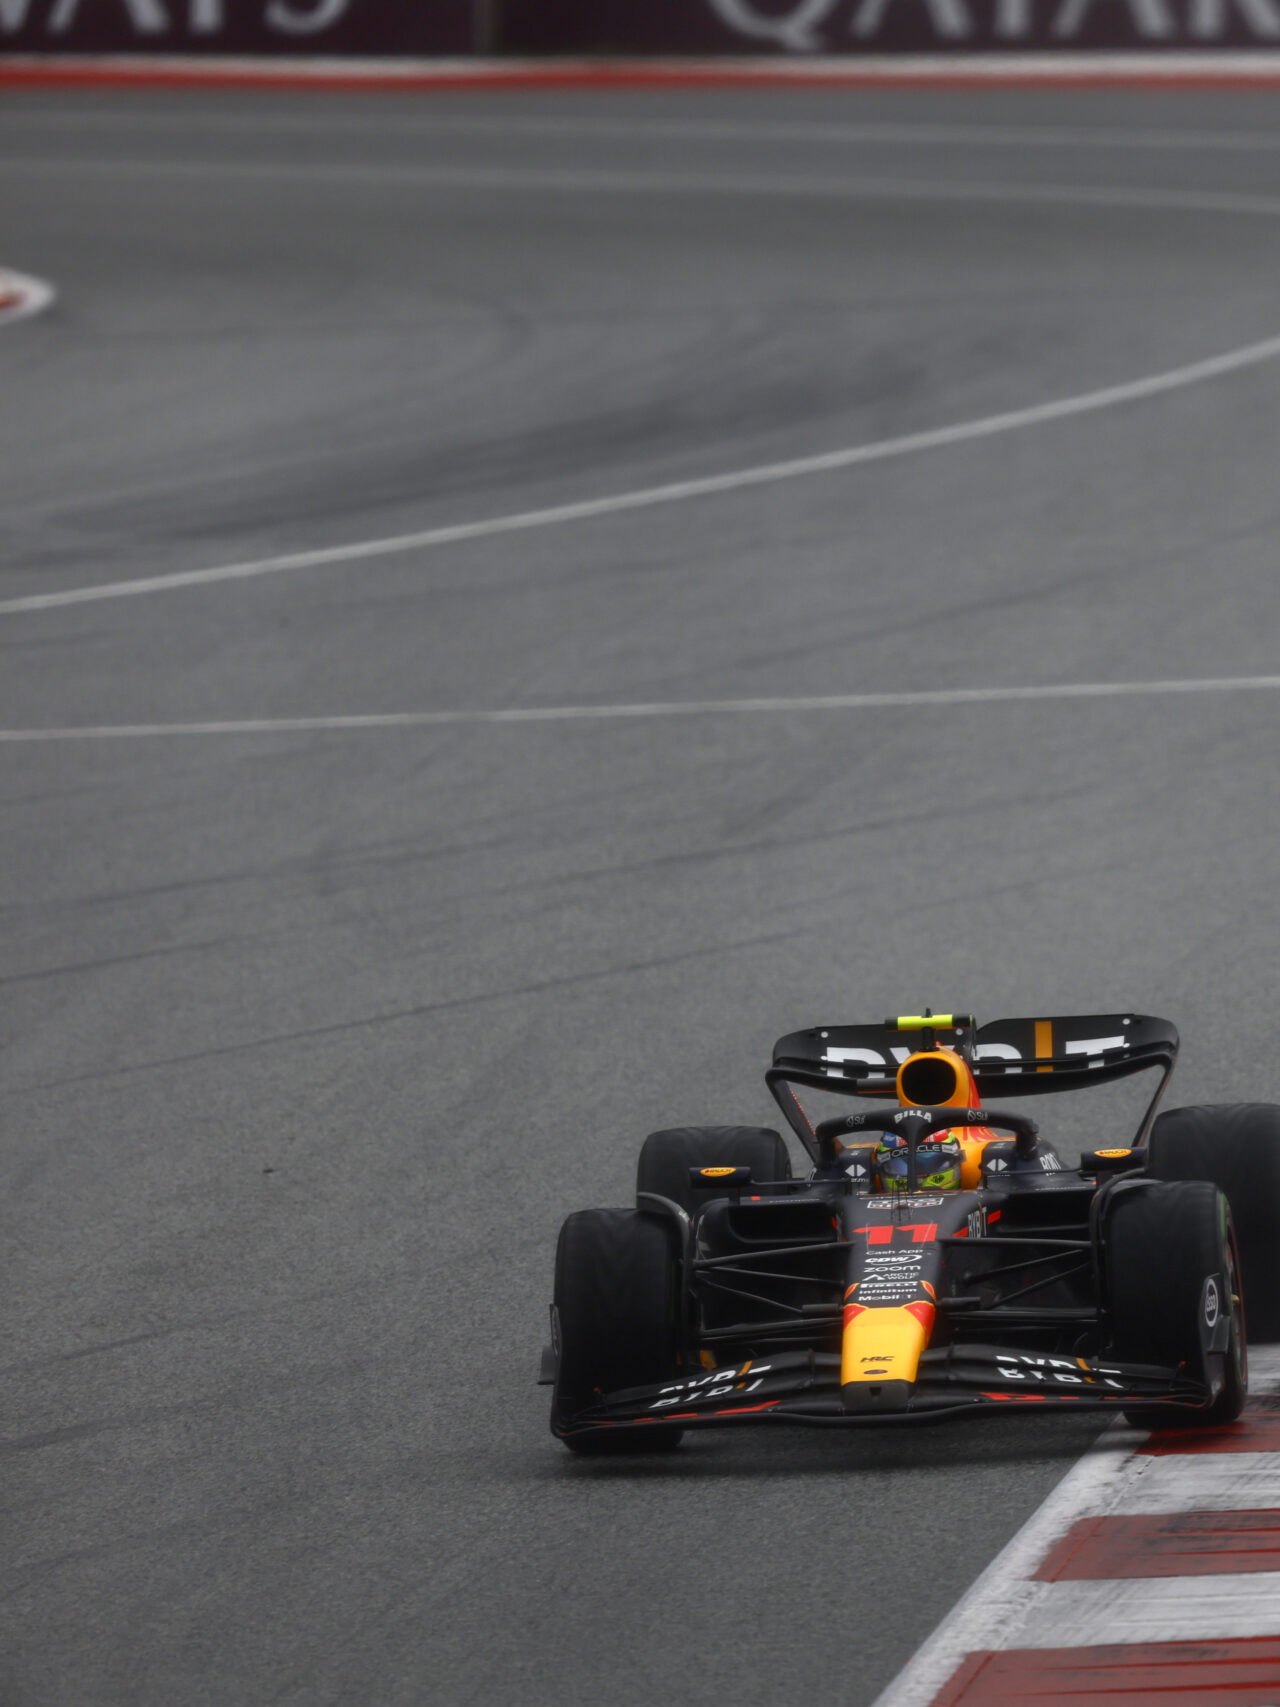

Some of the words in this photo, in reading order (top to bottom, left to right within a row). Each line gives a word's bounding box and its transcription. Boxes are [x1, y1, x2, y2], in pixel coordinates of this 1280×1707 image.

[894, 1109, 933, 1124] BILLA
[891, 1144, 941, 1158] ORCLE
[852, 1223, 939, 1245] 11
[865, 1255, 915, 1263] CDW
[863, 1265, 921, 1273] zoom
